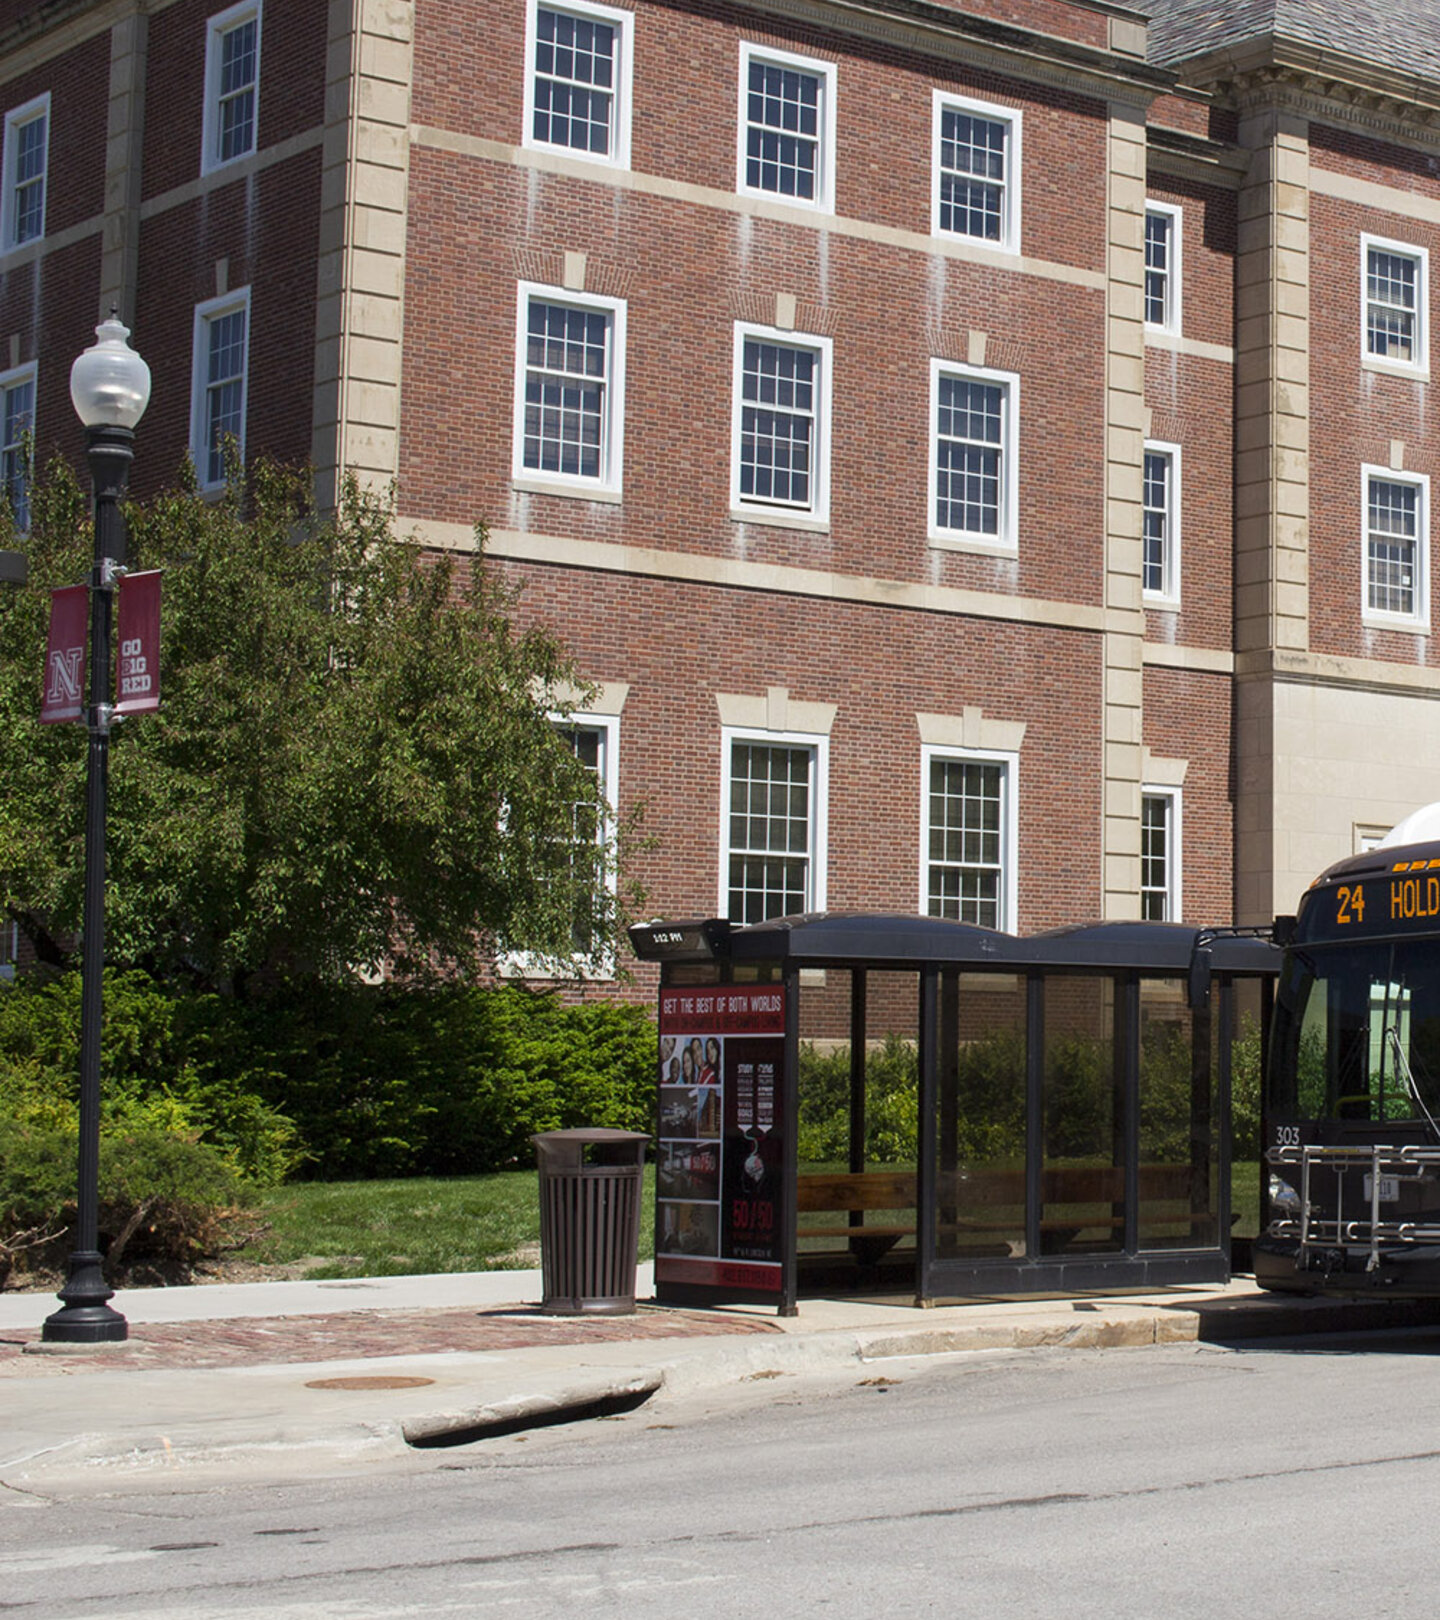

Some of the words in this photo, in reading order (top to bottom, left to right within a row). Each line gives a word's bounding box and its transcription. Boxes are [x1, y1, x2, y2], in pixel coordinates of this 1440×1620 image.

[122, 638, 142, 657] GO
[47, 647, 84, 703] N
[121, 674, 152, 694] RED
[1337, 885, 1366, 924] 24
[670, 932, 683, 942] PM
[663, 998, 678, 1014] GET
[680, 997, 694, 1013] THE
[696, 997, 715, 1013] BEST
[716, 997, 726, 1013] OF
[728, 996, 748, 1012] BOTH
[750, 995, 782, 1012] WORLDS
[1276, 1126, 1300, 1145] 303
